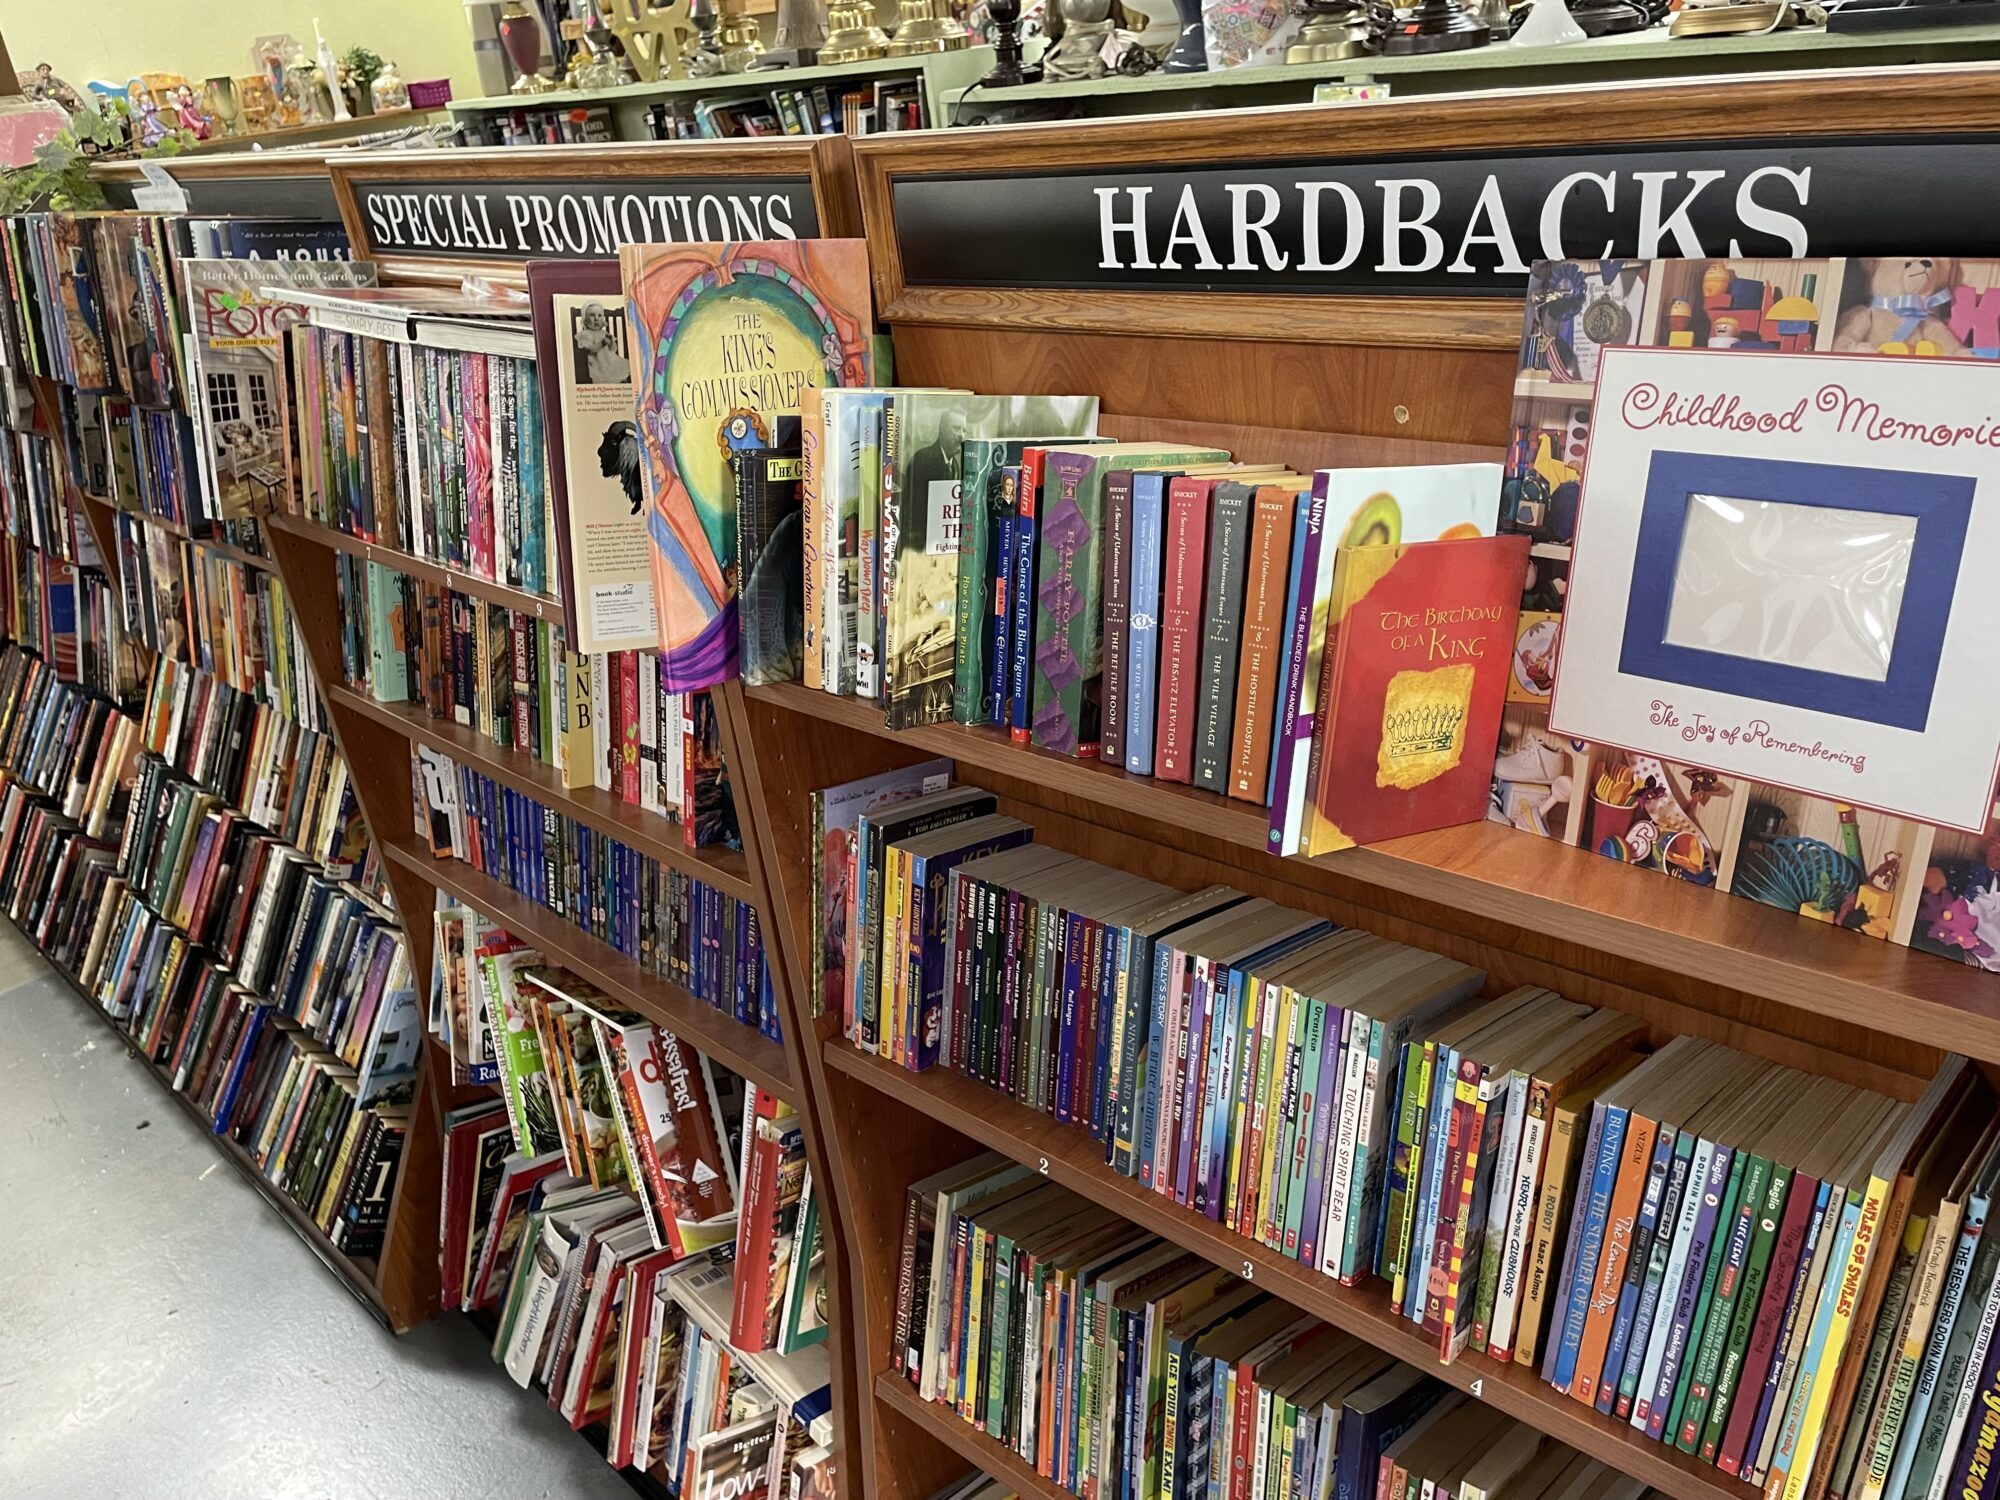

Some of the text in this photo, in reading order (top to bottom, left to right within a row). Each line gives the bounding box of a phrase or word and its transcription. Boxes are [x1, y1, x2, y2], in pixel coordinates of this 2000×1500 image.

[580, 120, 603, 133] Tom
[367, 193, 798, 255] SPECIAL PROMOTIONS
[1094, 166, 1812, 273] HARDBACKS
[203, 271, 238, 281] Better
[290, 272, 314, 282] and
[317, 272, 368, 282] Gardens
[734, 313, 761, 330] THE
[721, 332, 776, 374] KING'S
[506, 360, 514, 395] Chicken
[681, 369, 816, 421] COMMISSIONERS
[508, 398, 516, 419] Soup
[1622, 382, 2000, 446] Childhood Memorie
[770, 461, 792, 478] THE
[1022, 464, 1032, 512] Bellairs
[803, 429, 818, 614] Gertie's Leap to Greatness
[1310, 497, 1326, 535] NINJA
[445, 573, 453, 588] 8
[858, 530, 874, 615] Way Down Deep
[535, 602, 543, 617] 9
[1013, 533, 1031, 698] The Curse of the Blue Figurine
[1167, 634, 1181, 747] THE ERSATZ ELEVATOR
[1285, 606, 1308, 736] THE BLENDED DRINK HANDBOOK
[1207, 654, 1222, 747] THE VILE VILLAGE
[1242, 652, 1261, 767] THE HOSTILE HOSPITAL
[518, 708, 529, 747] PATTERSON
[1650, 700, 1867, 774] The Joy of Remembering
[548, 861, 556, 908] TURNCOAT
[968, 882, 976, 918] SURVIVOR
[1038, 911, 1047, 969] SHATTERED
[1069, 920, 1081, 965] The Bully
[1157, 950, 1169, 1028] MOLLY'S STORY
[487, 963, 513, 1072] Fresh, Fast and Fabulous
[1066, 1003, 1074, 1026] Langan
[1310, 1006, 1324, 1052] Orenstein
[1122, 1021, 1137, 1100] NINTH WARD
[1188, 1031, 1199, 1085] Snow Treasure
[1220, 1035, 1233, 1100] Secret Mission
[1175, 1076, 1184, 1093] Boy
[1175, 1094, 1182, 1103] at
[1291, 1068, 1299, 1090] PUPPY
[659, 1112, 673, 1124] 25
[1173, 1104, 1182, 1121] War
[1287, 1092, 1296, 1117] PLACE
[1404, 1091, 1418, 1126] AFTER
[1038, 1158, 1050, 1174] 2
[1331, 1087, 1358, 1223] TOUCHING SPIRIT BEAR
[1632, 1129, 1647, 1165] NUZUM
[641, 1133, 669, 1209] dinner's ready!
[1450, 1150, 1462, 1185] The Chase
[1710, 1152, 1727, 1185] Baglio
[1542, 1194, 1557, 1232] ROBOT
[1659, 1158, 1688, 1239] SPY GEAR
[1768, 1177, 1785, 1210] Baglio
[1824, 1191, 1841, 1231] BIOGRAPHY
[908, 1198, 917, 1235] NIELSEN
[1563, 1115, 1622, 1351] BUNTING THE SUMMER OF RILEY
[1242, 1261, 1255, 1280] 3
[1536, 1239, 1549, 1264] Isaac
[1836, 1196, 1881, 1319] MILES OF SMILES
[1919, 1234, 1948, 1308] McCrady/Kendrick
[894, 1243, 915, 1346] WORDS ON FIRE
[1530, 1264, 1545, 1303] Asimov
[1659, 1262, 1682, 1329] THE JUNIOR NOVEL
[1678, 1240, 1706, 1319] Pet Finders Club
[1732, 1268, 1761, 1347] Pet Finders Club
[1918, 1245, 1972, 1397] THE RESCUERS DOWN UNDER
[1985, 1312, 1995, 1323] DO
[1988, 1300, 1997, 1311] TO
[1973, 1351, 1984, 1361] IN
[1975, 1324, 1993, 1351] BETTER
[1169, 1354, 1179, 1380] ACE
[1657, 1323, 1685, 1397] Looking for Lola
[1780, 1358, 1796, 1392] Davidson
[1964, 1361, 1982, 1391] SCHOOL
[1165, 1383, 1178, 1417] YOUR
[1469, 1378, 1484, 1397] 4
[1711, 1350, 1740, 1425] Rescuing Raisin
[1857, 1351, 1882, 1416] GARY PAULSEN
[1870, 1359, 1916, 1485] THE PERFECT RIDE
[1957, 1391, 1970, 1418] Colman
[733, 1432, 774, 1452] Better
[1161, 1449, 1175, 1494] EXAM!
